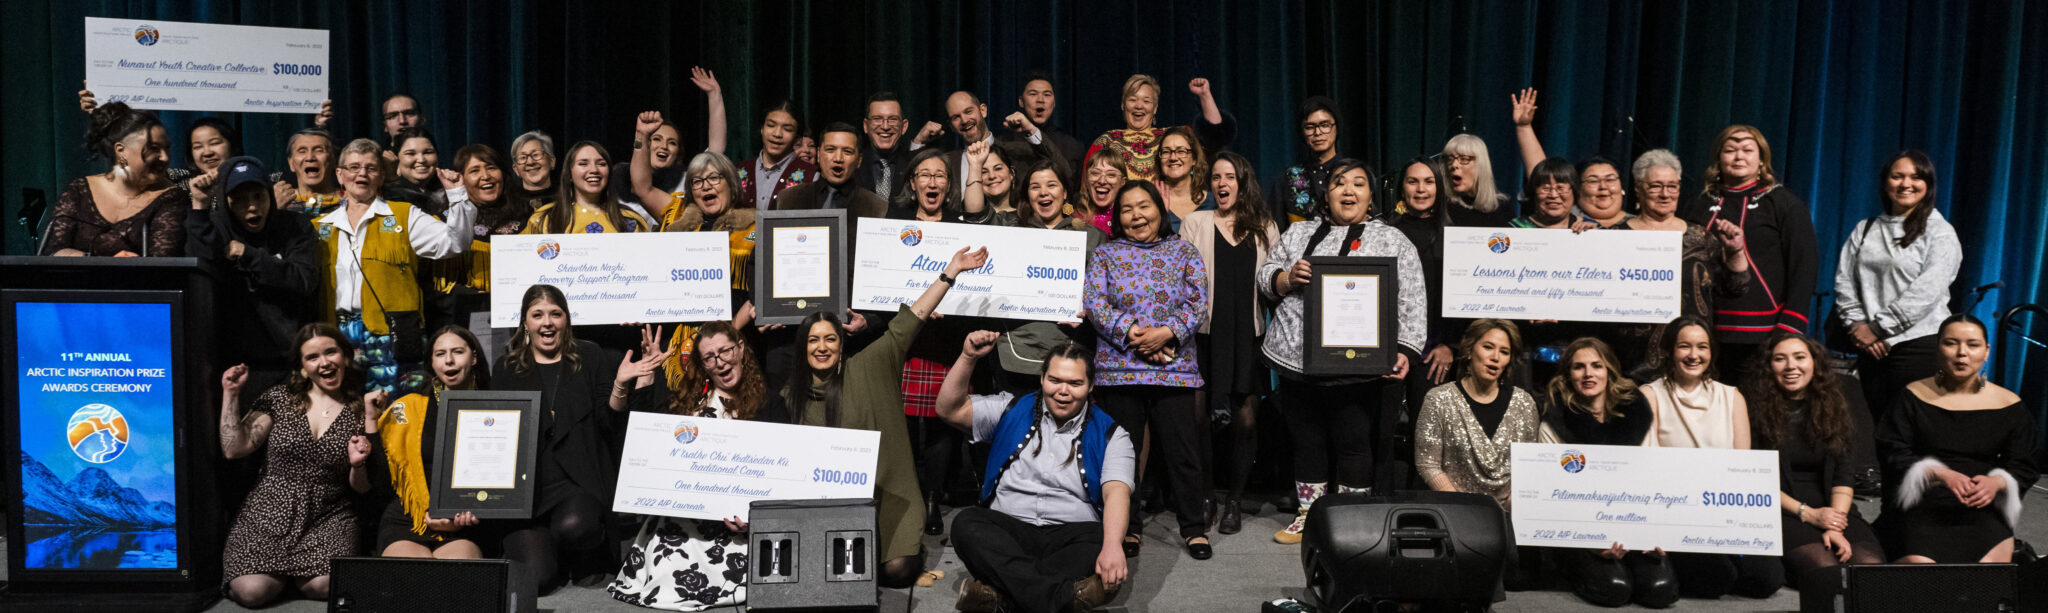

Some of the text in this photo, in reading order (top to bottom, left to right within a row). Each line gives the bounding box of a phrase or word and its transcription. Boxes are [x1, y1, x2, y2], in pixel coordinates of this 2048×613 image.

[118, 59, 157, 69] Nunavut
[159, 60, 182, 70] Youth
[186, 61, 221, 72] Creative
[224, 63, 264, 73] Collective
[273, 62, 322, 76] $100,000
[144, 77, 237, 88] One hundred thousand
[671, 268, 723, 282] $500,000
[1026, 265, 1078, 280] $500,000
[1473, 265, 1516, 278] Lessons
[1518, 266, 1548, 283] from
[1552, 270, 1572, 279] our
[1576, 267, 1612, 280] Elders
[1620, 268, 1674, 282] $450,000
[538, 274, 648, 287] Recovery Support Program
[906, 279, 920, 288] Five
[956, 282, 992, 292] thousand
[1496, 287, 1530, 295] hundred
[1547, 288, 1565, 299] fifty
[1567, 288, 1605, 297] thousand
[565, 291, 637, 301] hundred thousand
[871, 296, 891, 304] 2022
[706, 306, 724, 316] Prize
[1058, 306, 1076, 318] Prize
[85, 353, 131, 362] ANNUAL
[27, 368, 165, 377] ARCTIC INSPIRATION PRIZE
[42, 383, 152, 392] AWARDS CEREMONY
[689, 462, 766, 478] Traditional Camp
[813, 467, 868, 485] $100,000
[674, 480, 772, 496] One hundred thousand
[634, 497, 657, 506] 2022
[1654, 492, 1688, 508] Project
[1702, 491, 1772, 508] $1,000,000
[1596, 511, 1647, 522] One million
[1533, 529, 1556, 539] 2022
